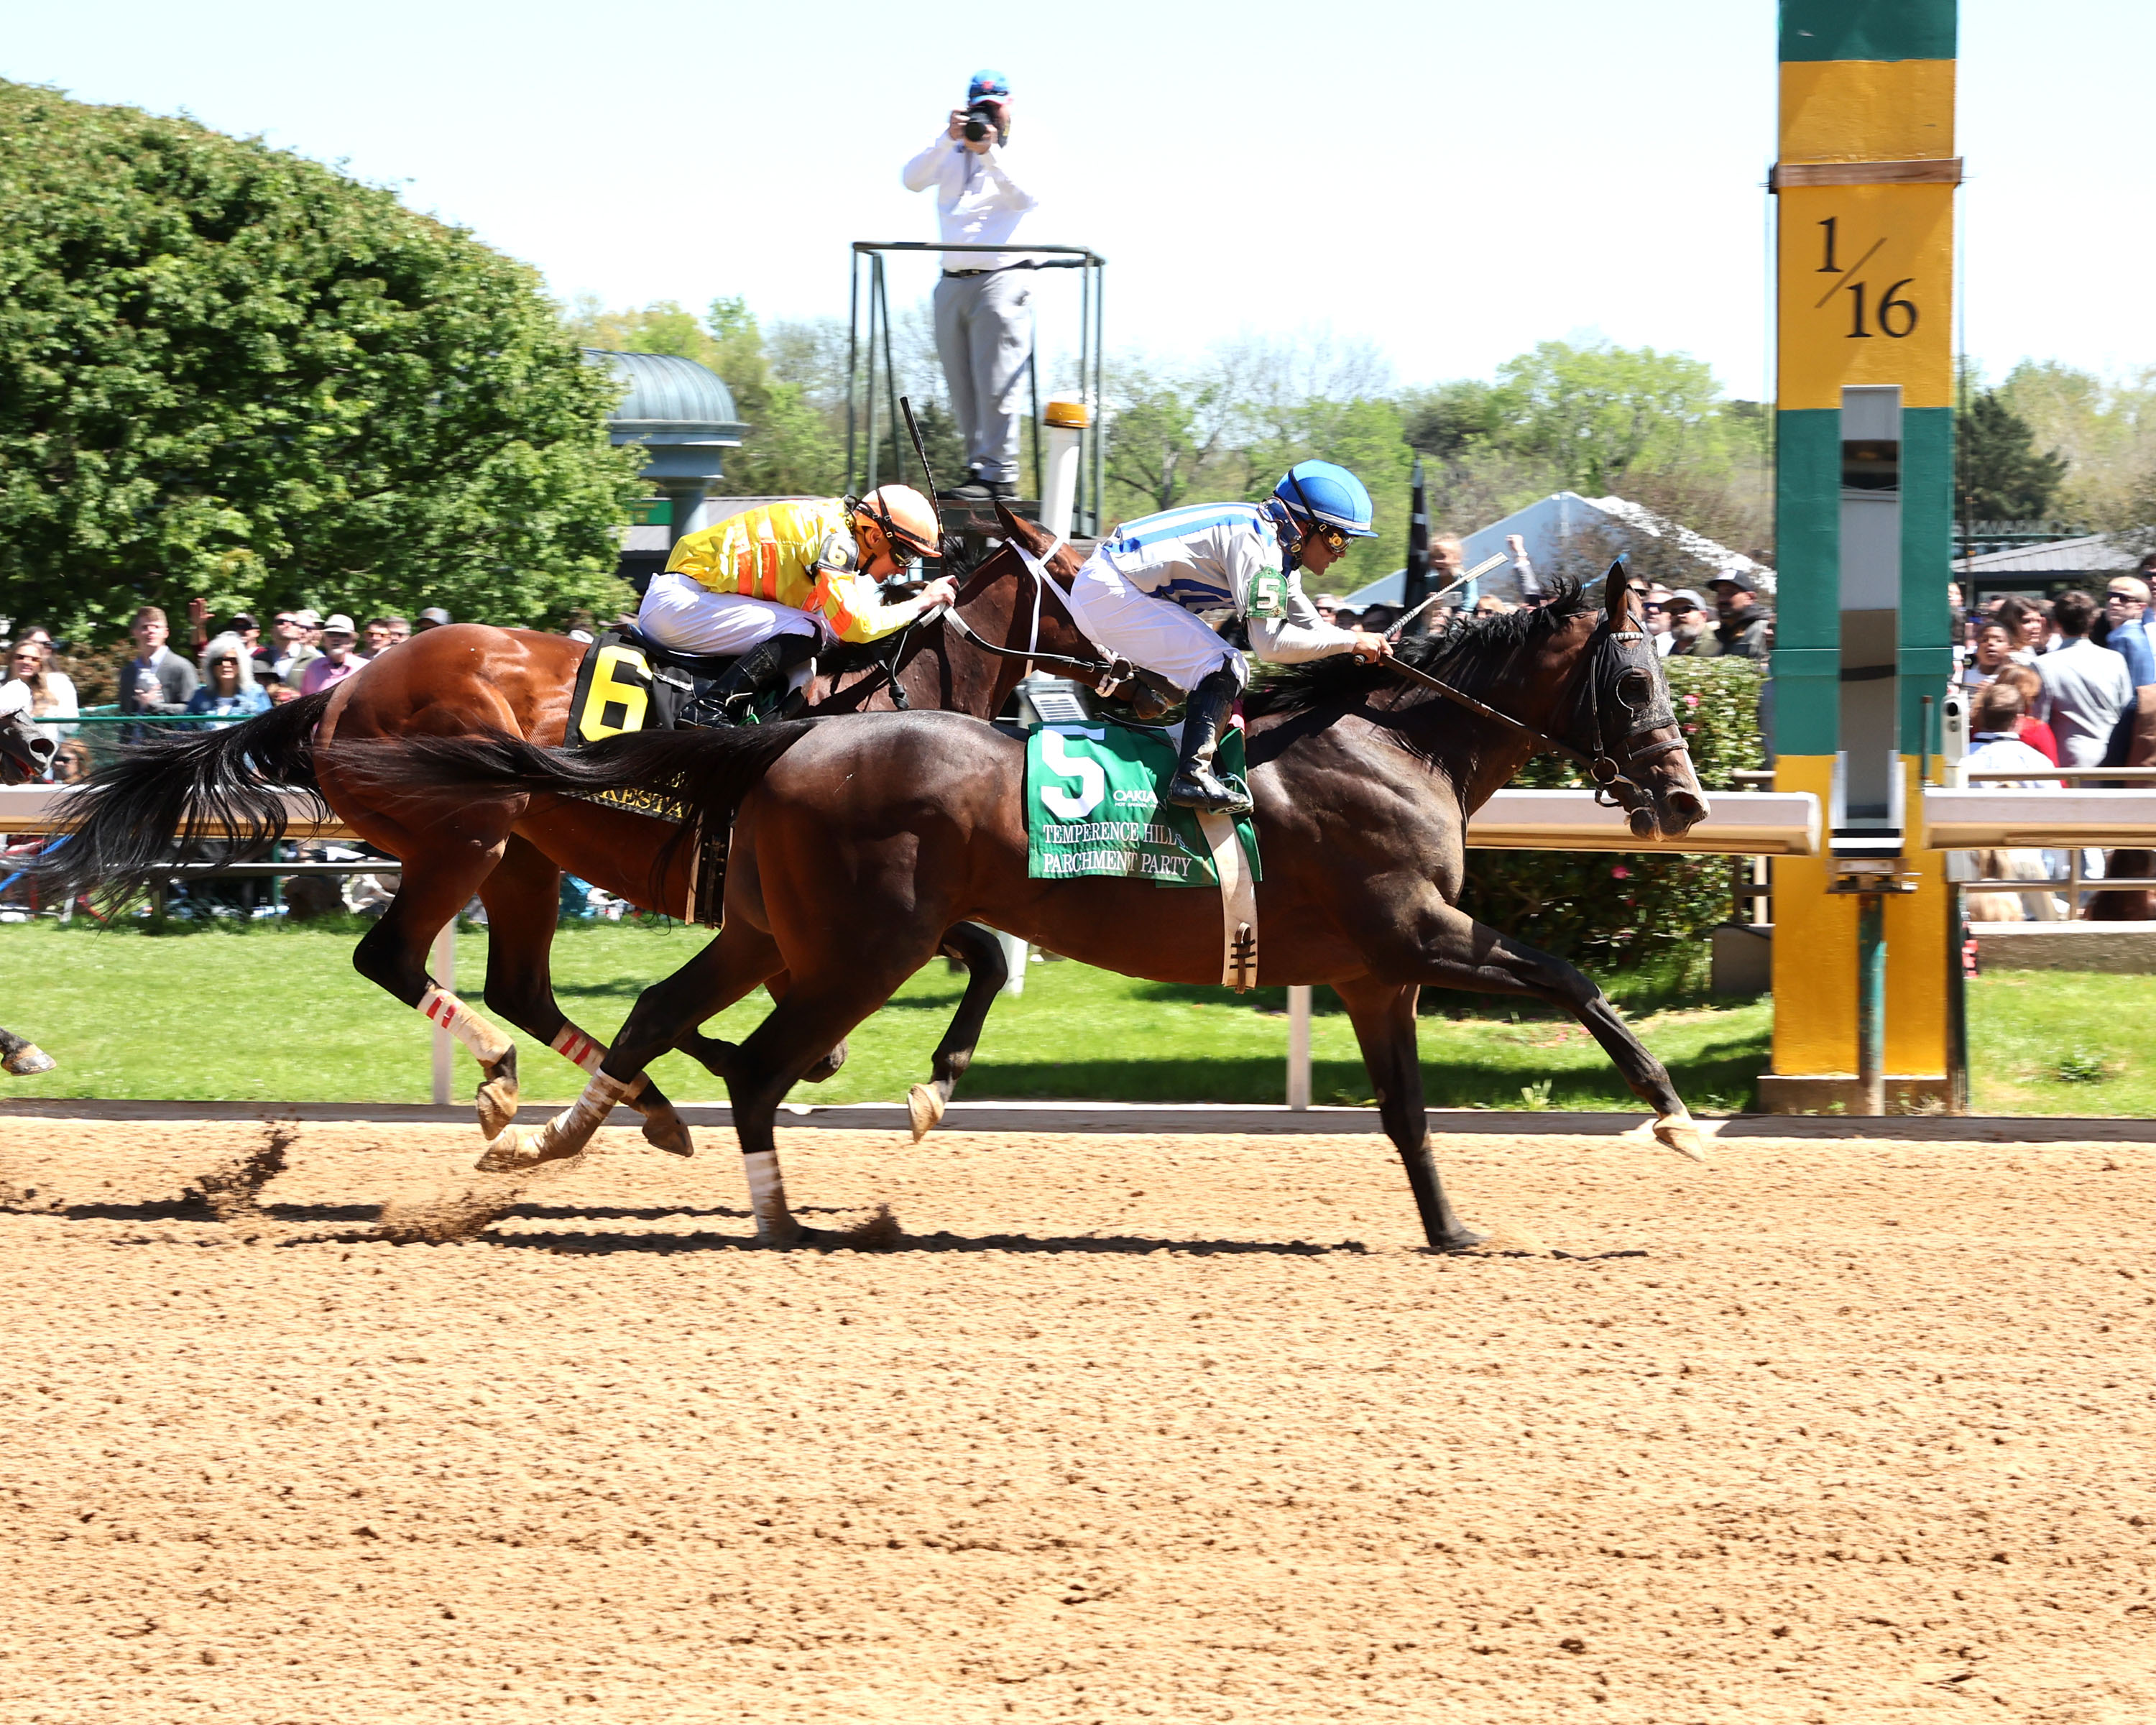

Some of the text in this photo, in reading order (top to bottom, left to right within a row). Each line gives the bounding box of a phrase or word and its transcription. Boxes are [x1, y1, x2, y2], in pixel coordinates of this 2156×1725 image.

[828, 538, 848, 566] 6
[1256, 577, 1280, 610] 5
[579, 645, 653, 742] 6
[1041, 725, 1105, 818] 5
[1043, 822, 1139, 844] TEMPERENCE
[1044, 850, 1192, 877] PARCHMENT PARTY
